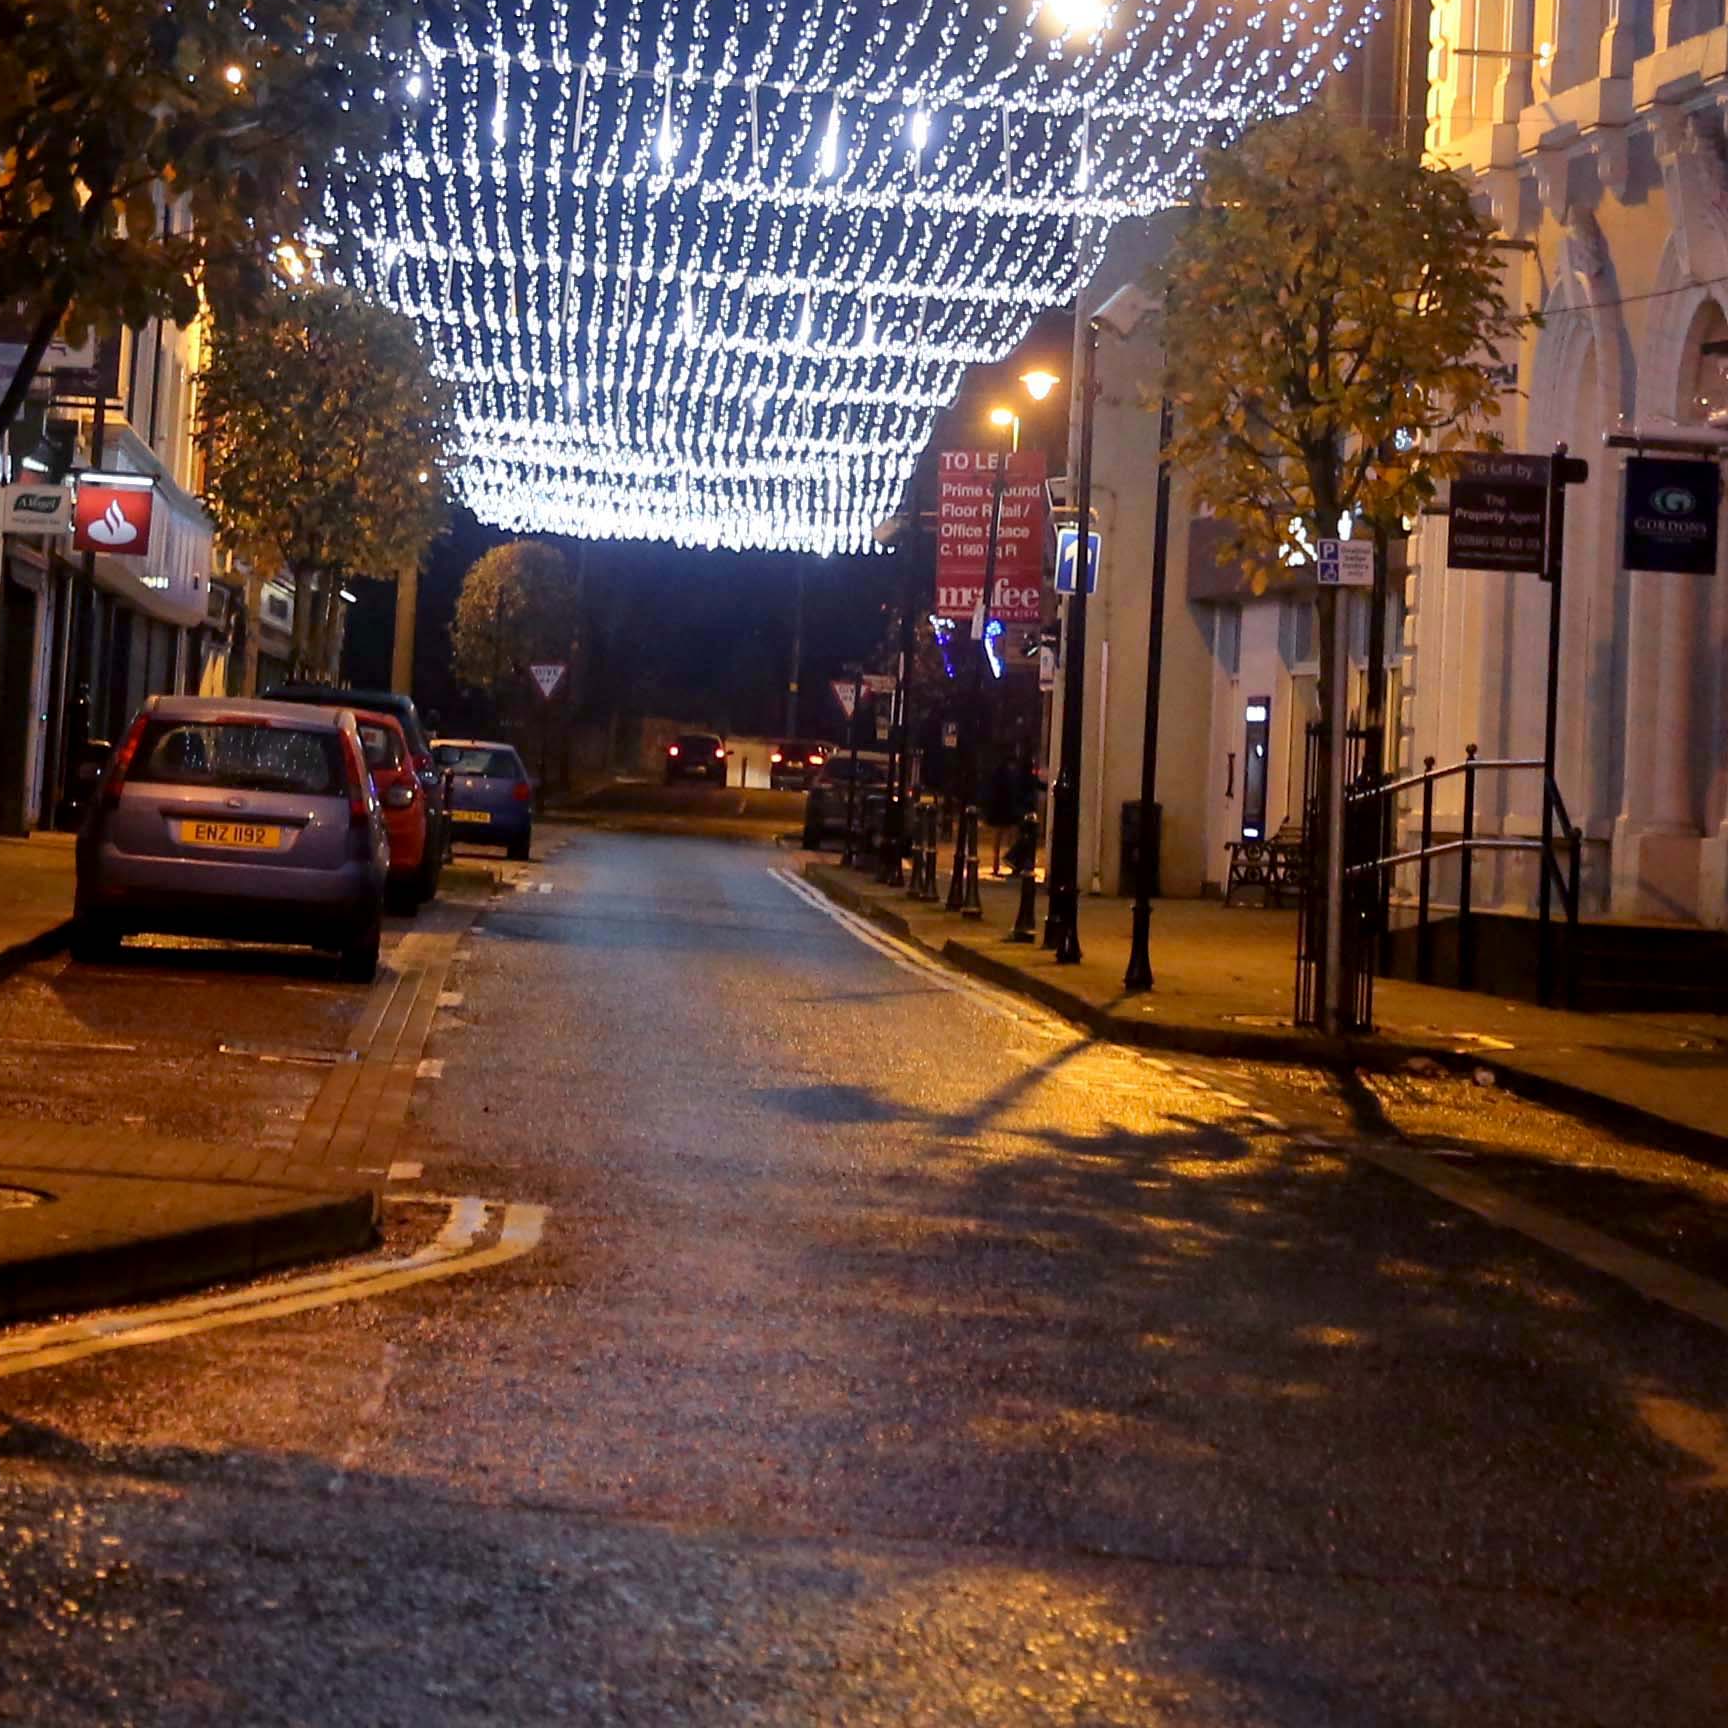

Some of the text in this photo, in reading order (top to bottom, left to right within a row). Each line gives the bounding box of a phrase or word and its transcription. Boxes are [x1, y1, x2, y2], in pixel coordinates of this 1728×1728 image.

[941, 452, 1013, 471] TO LET
[942, 482, 1041, 498] Prime ound
[942, 503, 979, 519] Floor
[981, 503, 1022, 519] Rtail
[1455, 507, 1506, 525] Property
[941, 522, 983, 539] Office
[195, 823, 266, 845] ENZ 1192
